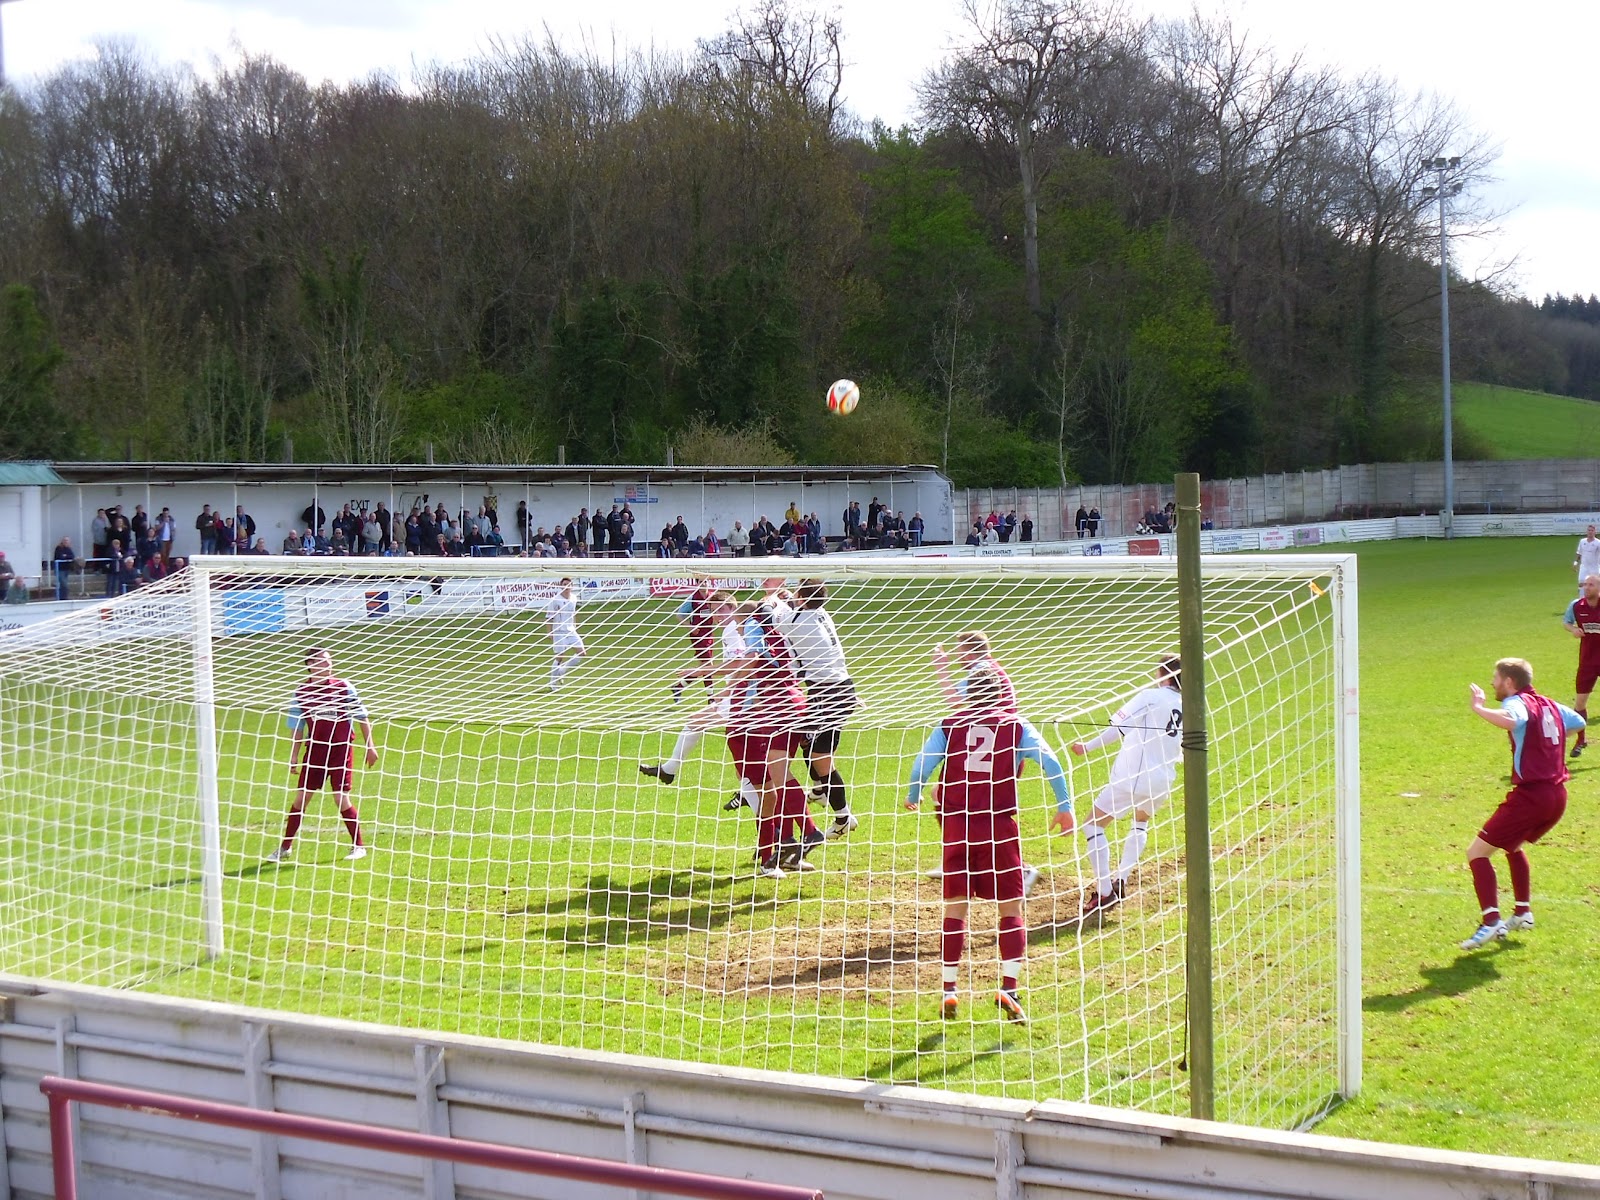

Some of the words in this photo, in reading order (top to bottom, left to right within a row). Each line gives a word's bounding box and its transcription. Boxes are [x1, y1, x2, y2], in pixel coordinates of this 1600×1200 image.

[351, 500, 370, 510] EXIT
[496, 582, 532, 594] AMERSHAM
[501, 595, 506, 603] &
[509, 594, 527, 602] DOOR
[528, 591, 558, 601] COMPANY
[1166, 709, 1182, 737] 8
[1542, 706, 1560, 745] 4
[964, 726, 996, 772] 2
